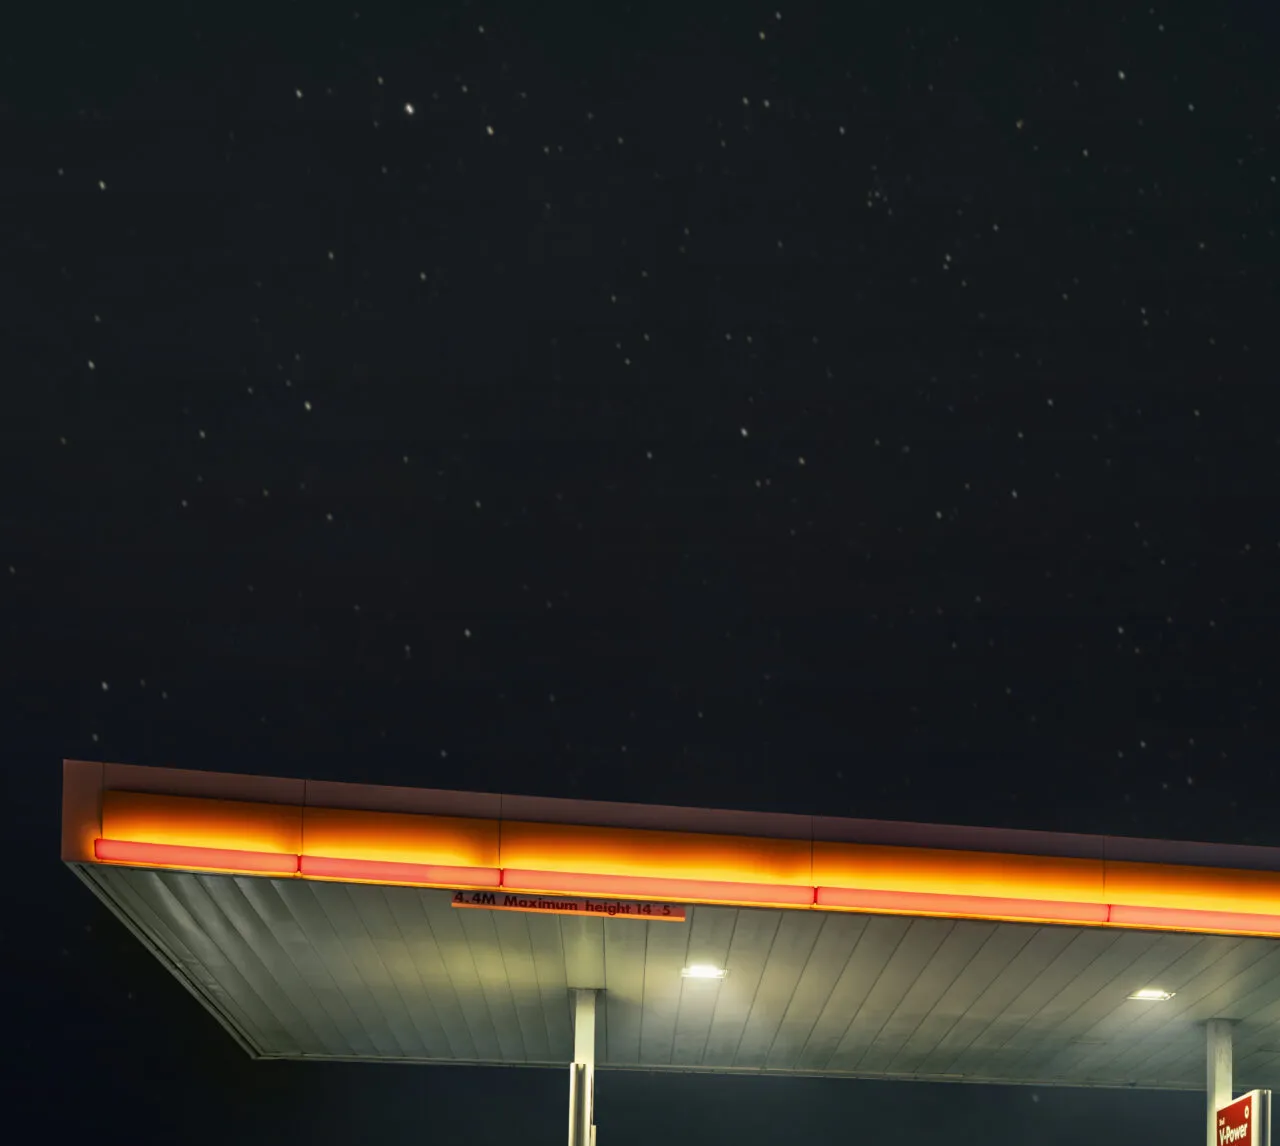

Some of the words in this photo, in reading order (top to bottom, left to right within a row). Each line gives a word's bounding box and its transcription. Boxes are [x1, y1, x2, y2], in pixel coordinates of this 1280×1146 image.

[453, 892, 496, 905] 4.4M
[503, 895, 578, 910] Maximum
[585, 900, 631, 915] height
[1219, 1123, 1248, 1146] V-Power
